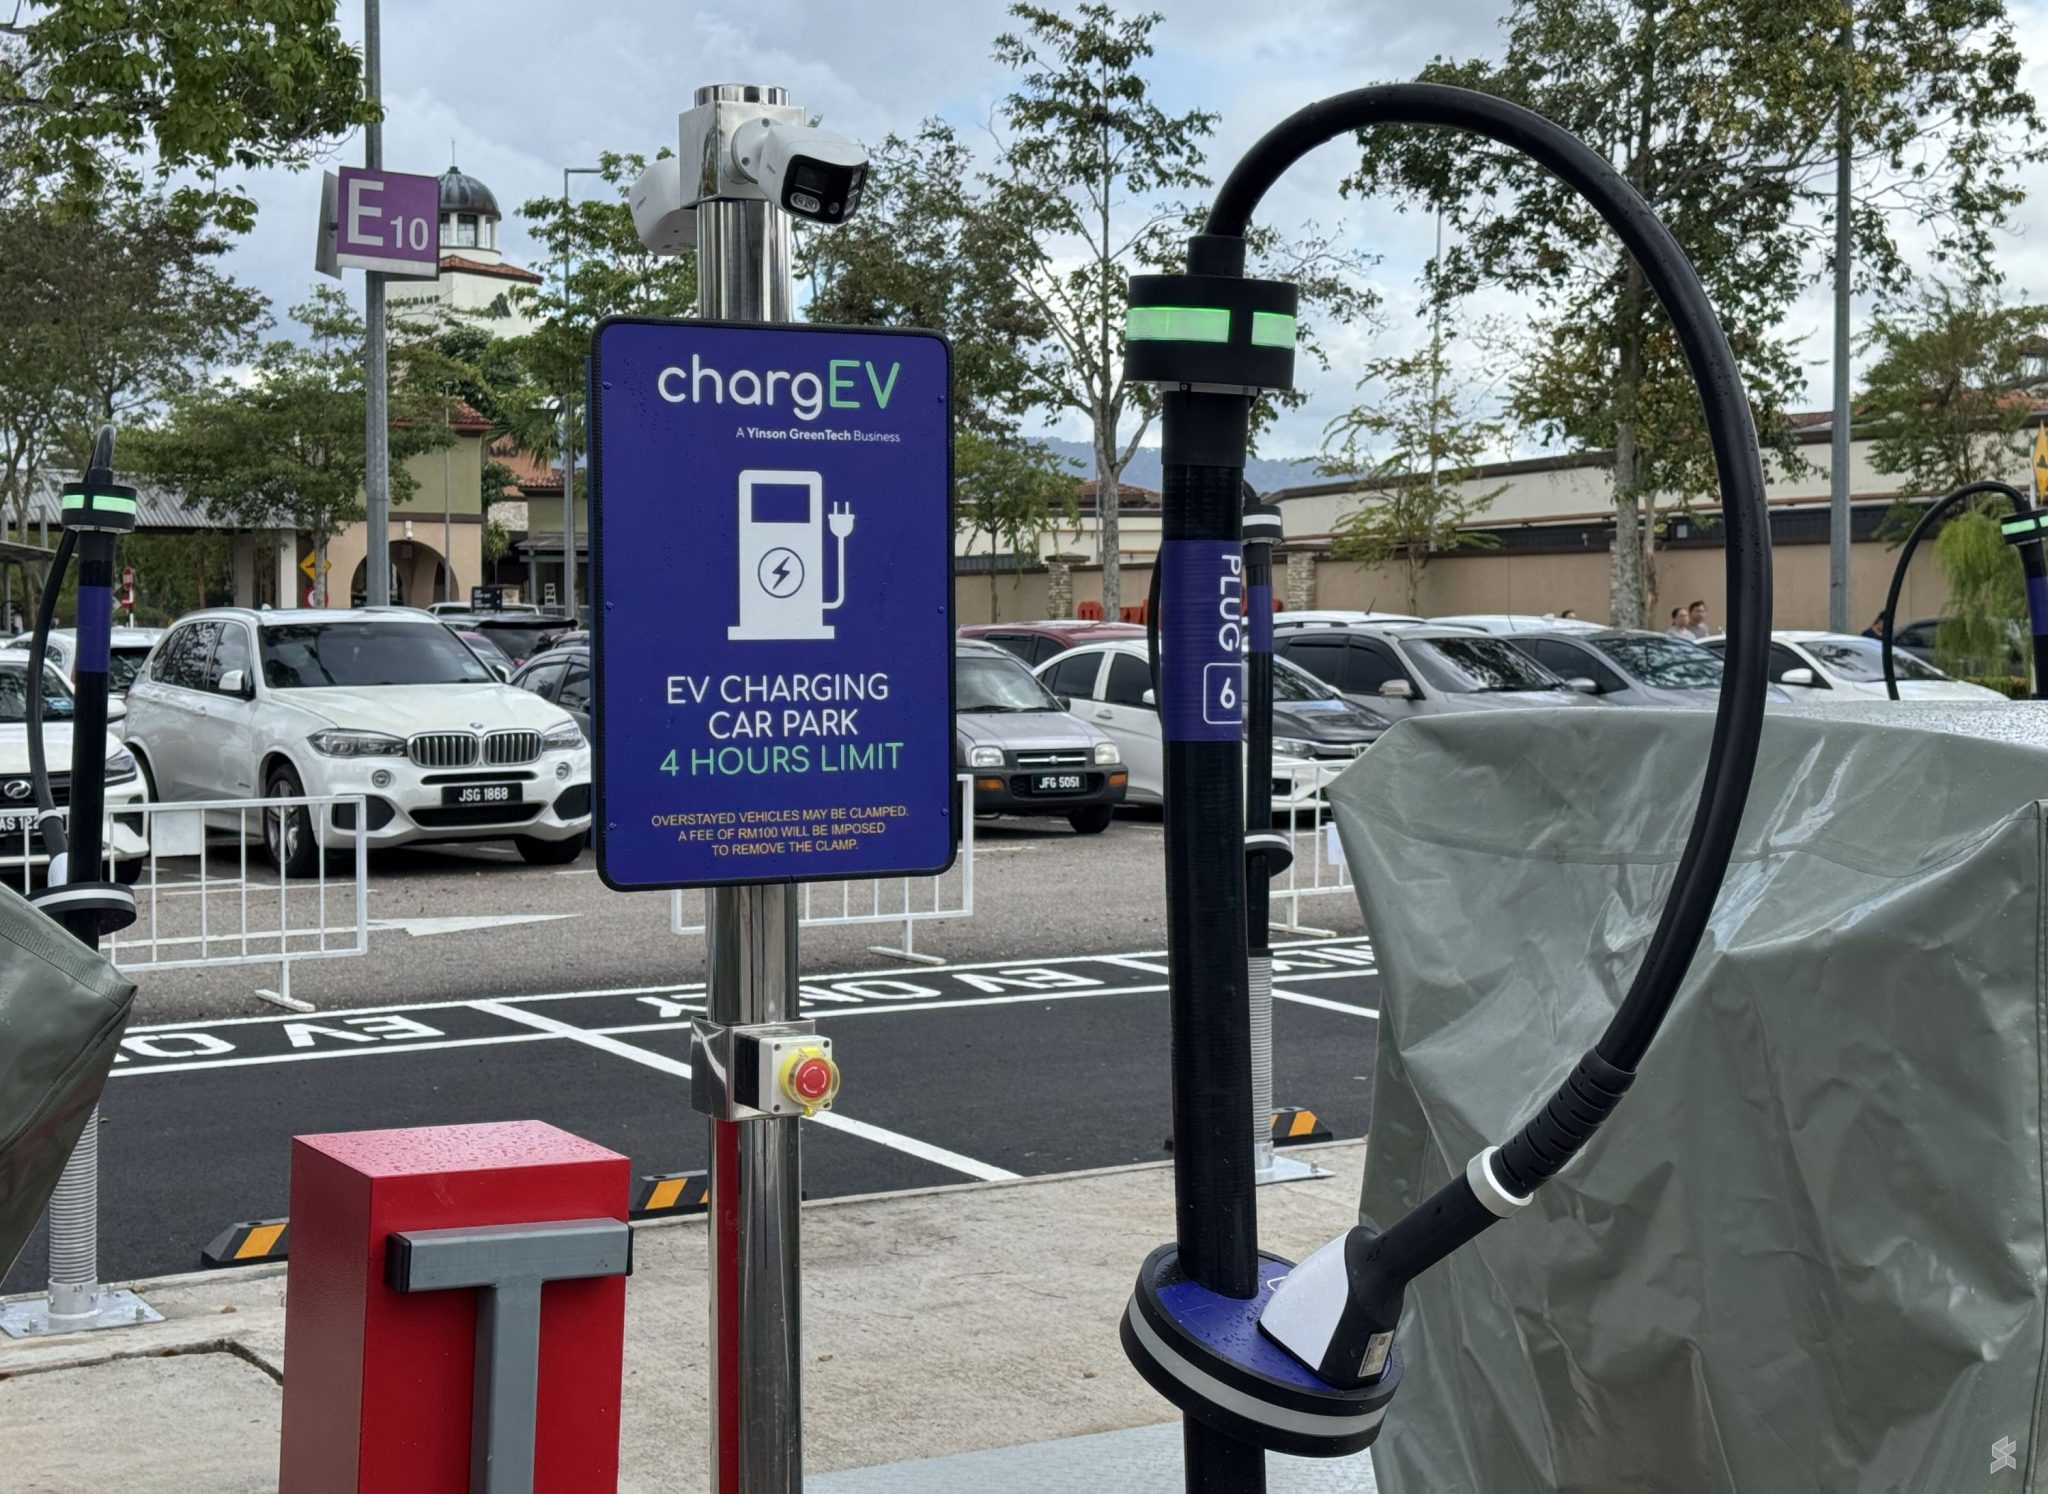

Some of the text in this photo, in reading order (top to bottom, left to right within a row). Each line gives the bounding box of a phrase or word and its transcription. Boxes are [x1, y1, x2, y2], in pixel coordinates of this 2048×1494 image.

[347, 178, 429, 251] E 10
[657, 353, 900, 421] chargEV
[736, 427, 901, 443] A Yinson GreenTech Business
[1218, 554, 1241, 652] PLUG
[667, 673, 889, 704] EV CHARGING
[1220, 677, 1236, 709] 6
[708, 708, 859, 740] CAR PARK
[659, 742, 904, 777] 4 HOURS LIMIT
[458, 786, 509, 802] JSG 1868
[1039, 776, 1080, 789] JFG 5051
[651, 805, 910, 827] OVERSTAYED VEHICLES MAY BE CLAMPED.
[678, 822, 886, 842] A FEE OF RM100 WILL BE IMPOSED
[712, 838, 859, 857] TO REMOVE THE CLAMP.
[952, 967, 1105, 993] EV
[283, 1014, 446, 1048] EV
